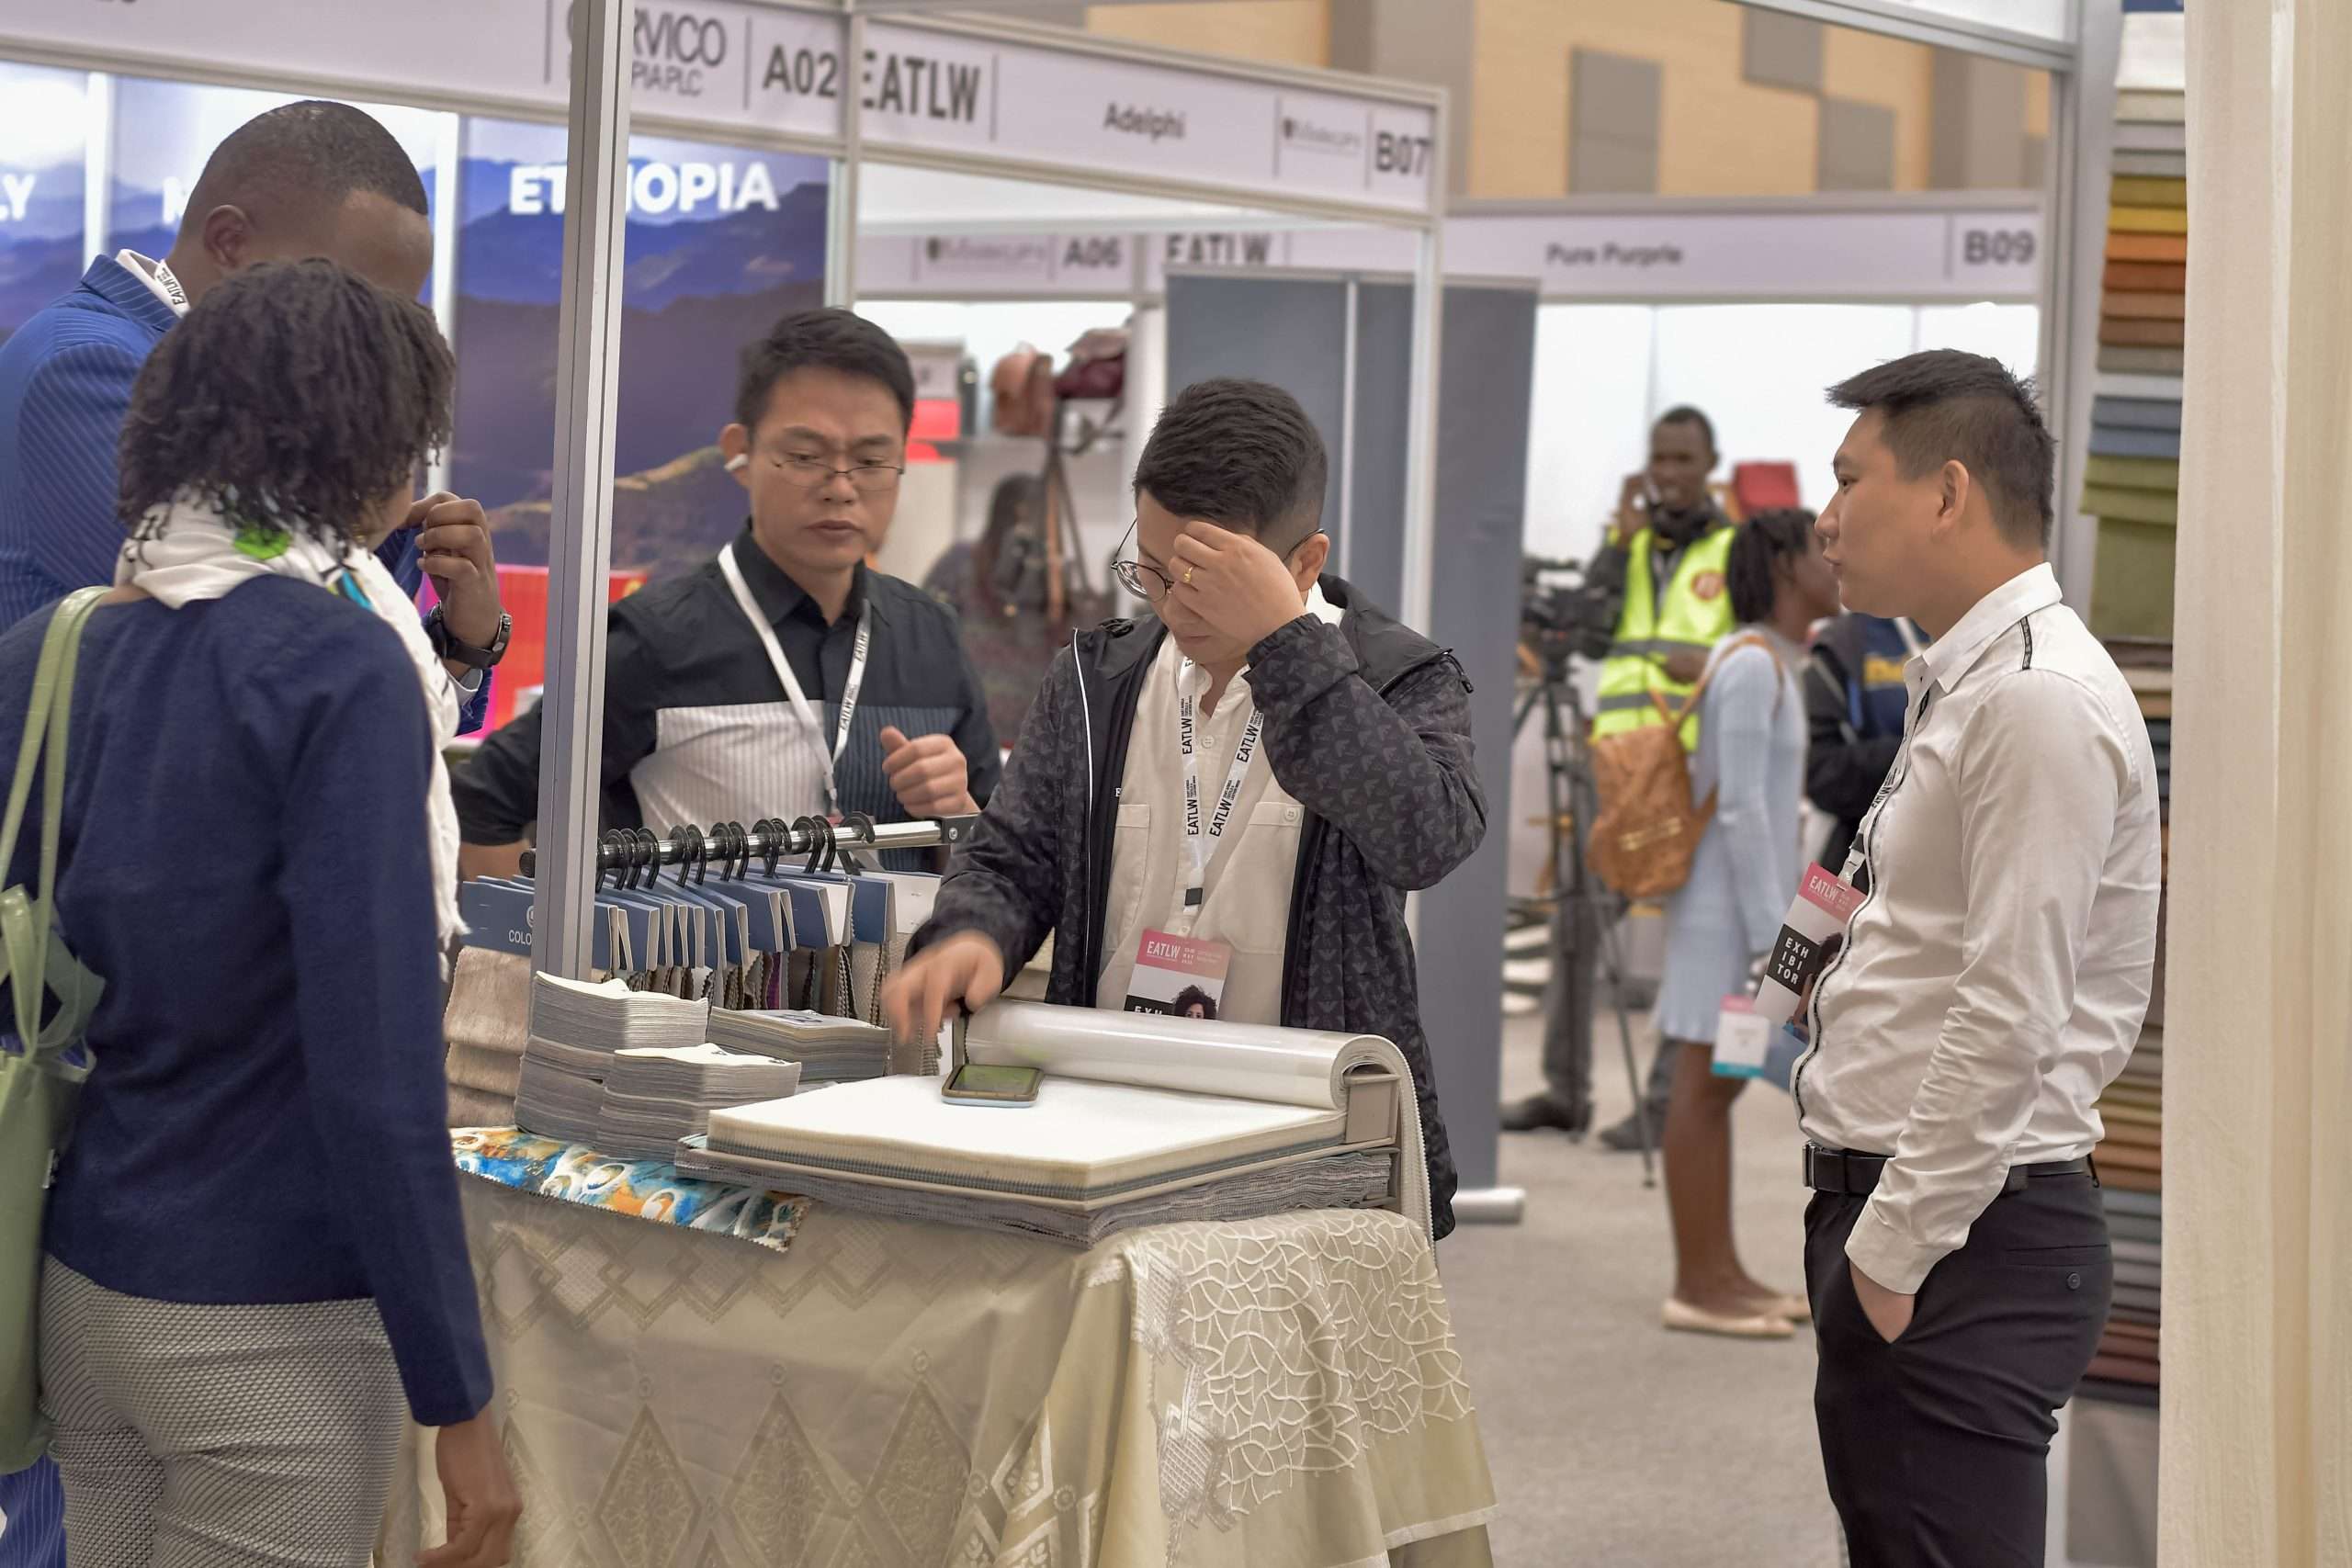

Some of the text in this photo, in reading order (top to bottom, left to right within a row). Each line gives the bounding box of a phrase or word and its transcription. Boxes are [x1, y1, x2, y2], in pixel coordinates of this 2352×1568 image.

[763, 45, 838, 97] A02
[863, 51, 980, 122] EATLW
[1103, 103, 1186, 141] Adelphi
[1375, 133, 1430, 175] B07
[0, 174, 36, 220] Y
[510, 162, 779, 214] ETOPIA
[1964, 230, 2035, 265] B09
[1181, 717, 1193, 754] EATLW
[1237, 725, 1260, 762] EATLW
[1187, 798, 1199, 836] EATLW
[1209, 798, 1232, 837] EATLW
[1809, 874, 1838, 901] EATLW
[508, 929, 533, 945] COLO
[1147, 941, 1182, 959] EATLW
[1785, 937, 1809, 959] EXH
[1777, 964, 1799, 985] TOR
